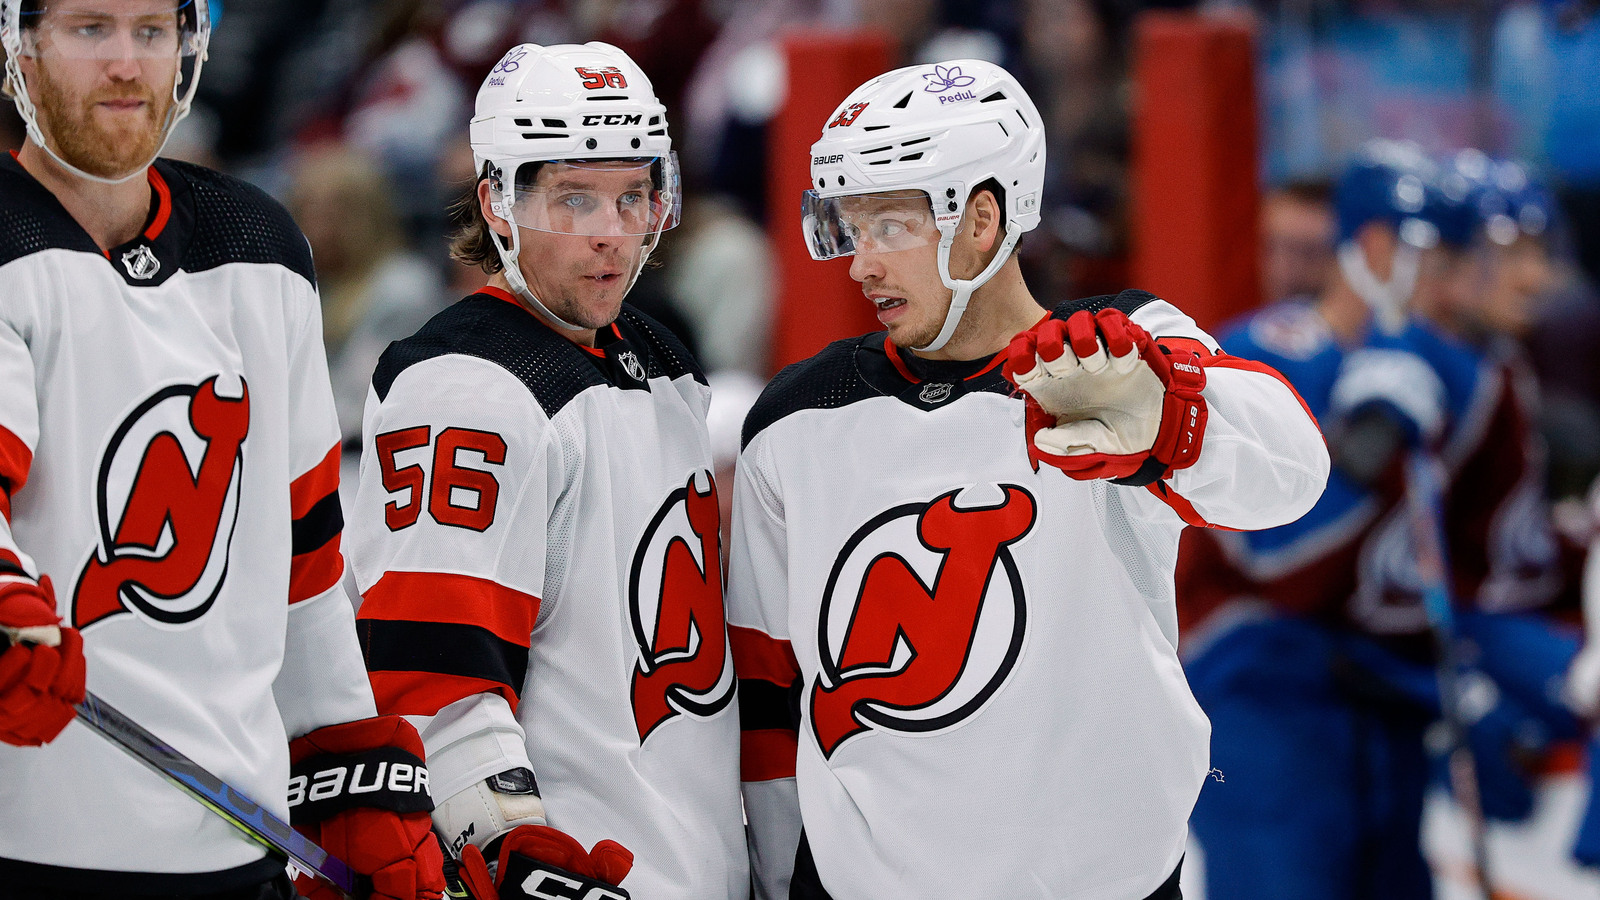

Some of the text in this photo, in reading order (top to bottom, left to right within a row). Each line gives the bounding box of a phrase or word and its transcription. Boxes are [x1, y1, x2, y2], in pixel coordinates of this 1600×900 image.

[575, 67, 629, 90] 56
[938, 89, 977, 105] PeduL
[582, 114, 643, 127] CCM
[375, 424, 508, 533] 56
